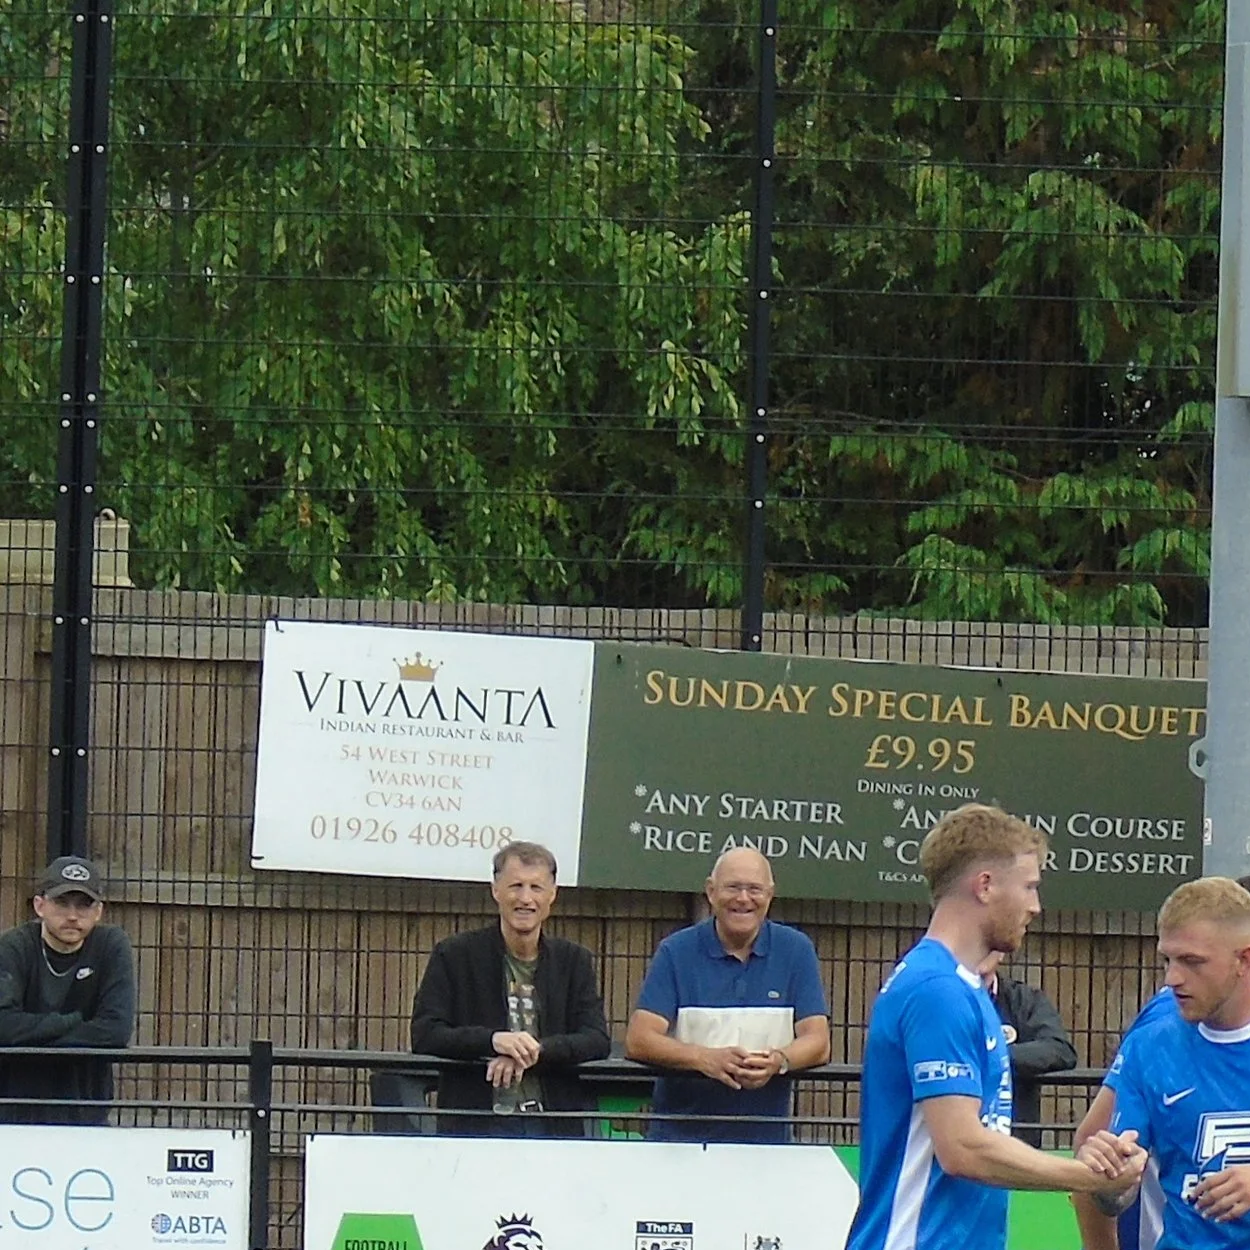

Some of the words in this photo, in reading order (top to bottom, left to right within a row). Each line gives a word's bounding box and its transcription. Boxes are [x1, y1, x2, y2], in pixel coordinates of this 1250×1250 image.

[643, 670, 819, 714] SUNDAY
[828, 683, 993, 726] SPECIAL
[1008, 694, 1207, 740] BANQUET
[319, 718, 376, 734] INDIAN
[381, 723, 475, 741] RESTAURANT
[479, 728, 491, 741] &
[496, 730, 524, 744] BAR
[340, 744, 362, 761] 54
[368, 746, 418, 764] WEST
[427, 749, 494, 769] STREET
[864, 735, 976, 774] £9.95
[368, 769, 463, 790] WARWICK
[857, 779, 913, 796] DINING
[918, 783, 935, 797] IN
[940, 784, 980, 799] ONLY
[364, 791, 415, 809] CV34
[421, 793, 462, 811] 6AN
[645, 789, 710, 816] ANY
[718, 793, 844, 824] STARTER
[900, 806, 945, 830] AN
[1066, 813, 1186, 840] COURSE
[310, 815, 397, 844] 01926
[408, 822, 514, 850] 408408
[643, 826, 712, 853] RICE
[719, 834, 789, 857] AND
[800, 835, 867, 861] NAN
[1068, 848, 1194, 875] DESSERT
[173, 1153, 209, 1168] TTG
[166, 1176, 197, 1186] Online
[198, 1177, 235, 1188] Agency
[171, 1189, 209, 1200] WINNER
[9, 1166, 115, 1232] se
[172, 1215, 227, 1234] ABTA
